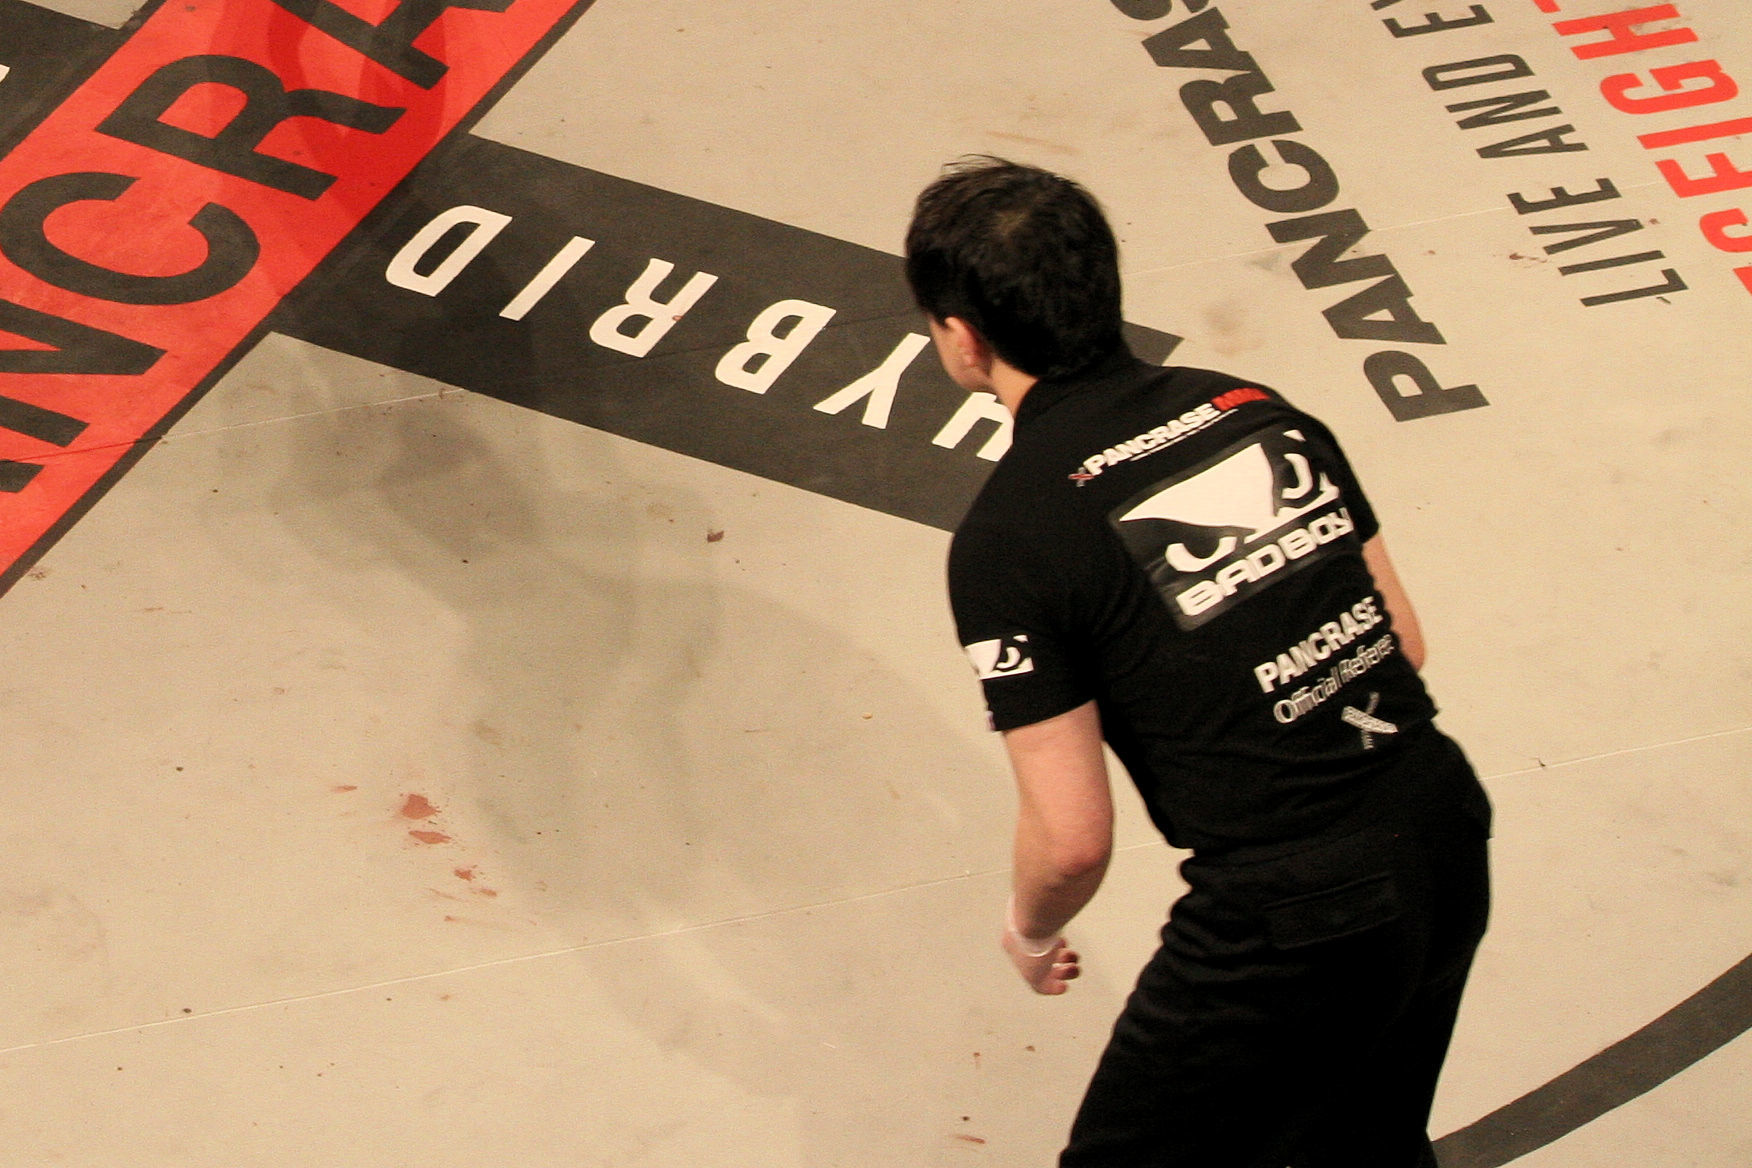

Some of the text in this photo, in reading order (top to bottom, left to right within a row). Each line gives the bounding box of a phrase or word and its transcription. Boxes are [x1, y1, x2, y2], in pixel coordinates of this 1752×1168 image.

[1421, 53, 1591, 159] AND
[1505, 176, 1690, 308] LIVE
[1083, 402, 1222, 477] PANCRASE
[1253, 595, 1384, 694] PANCRASE
